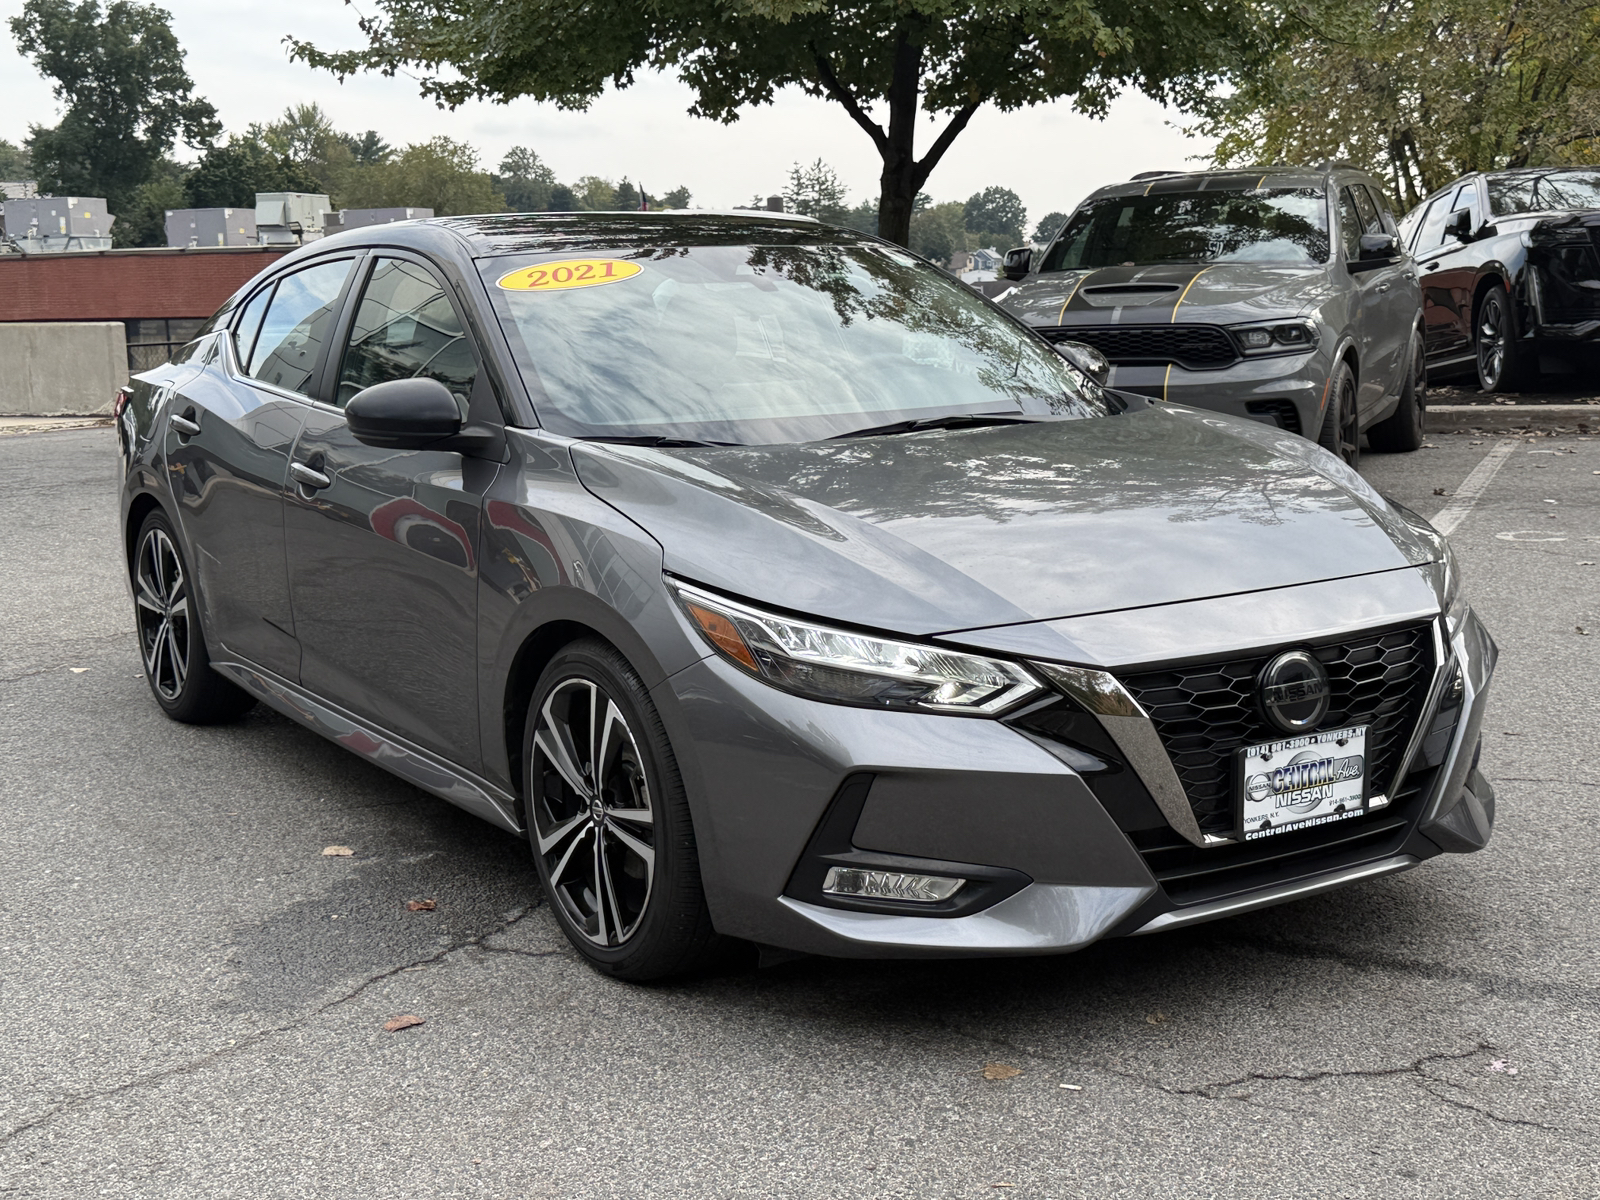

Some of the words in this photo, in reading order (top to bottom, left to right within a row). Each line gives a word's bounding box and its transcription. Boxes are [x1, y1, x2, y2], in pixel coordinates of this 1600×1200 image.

[527, 261, 618, 288] 2021
[1273, 681, 1323, 703] NISSAN
[1248, 781, 1271, 792] NISSAN
[1273, 758, 1335, 793] CENTRAL
[1336, 758, 1360, 780] Ave.
[1275, 784, 1334, 809] NISSAN
